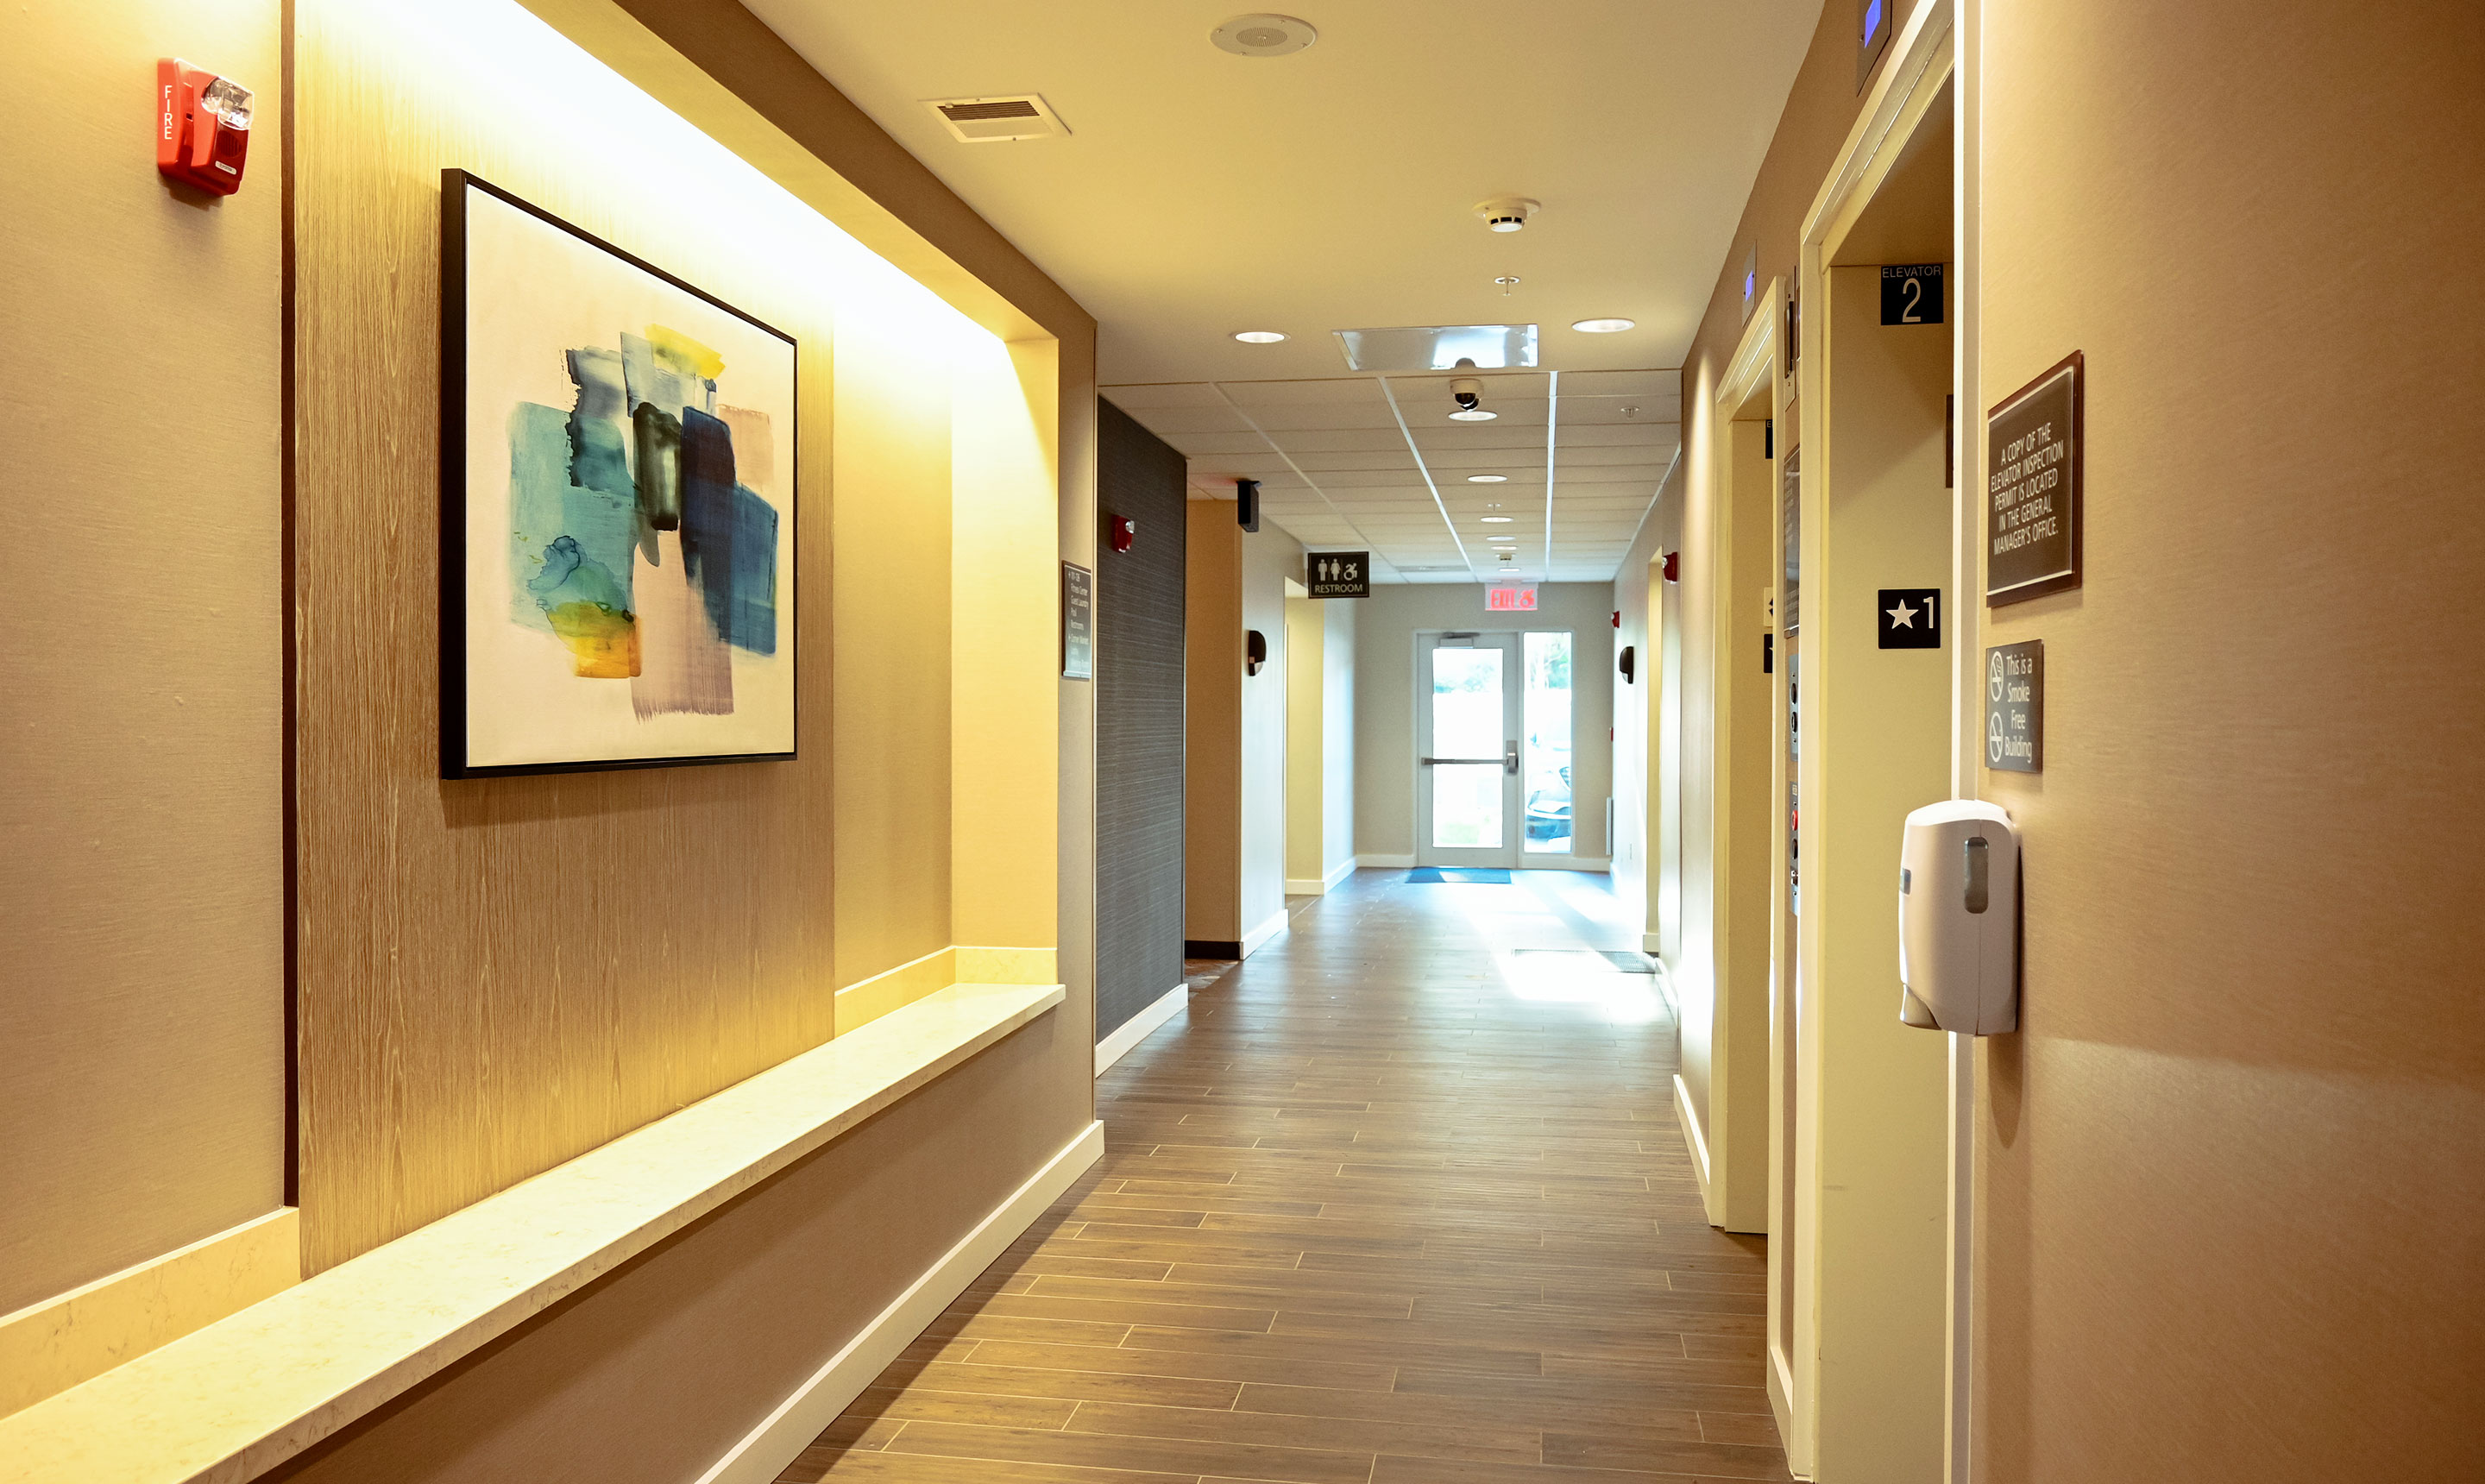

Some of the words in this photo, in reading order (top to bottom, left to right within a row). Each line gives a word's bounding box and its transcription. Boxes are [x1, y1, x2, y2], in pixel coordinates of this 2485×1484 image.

[164, 85, 173, 140] FIRE
[1882, 266, 1941, 278] ELEVATOR
[1902, 277, 1921, 323] 2
[2001, 448, 2006, 467] A
[2008, 437, 2025, 462] COPY
[2026, 431, 2035, 452] OF
[2037, 422, 2051, 446] THE
[1991, 462, 2022, 493] ELEVATOR
[2023, 439, 2064, 477] INSPECTION
[1995, 486, 2018, 512] PERMIT
[2019, 482, 2025, 501] IS
[2026, 468, 2059, 498] LOCATED
[1999, 513, 2006, 532] IN
[2007, 507, 2019, 528] THE
[2021, 494, 2053, 523] GENERAL
[1994, 525, 2031, 556] MANAGER'S
[2032, 516, 2059, 542] OFFICE.
[1314, 583, 1363, 594] RESTROOM
[1490, 588, 1515, 608] EXIT
[1922, 596, 1934, 629] 1
[2006, 654, 2019, 676] This
[2021, 653, 2026, 675] is
[2028, 659, 2033, 674] a
[2007, 682, 2030, 703] Smoke
[2010, 709, 2026, 730] Free
[2004, 736, 2033, 764] Building
